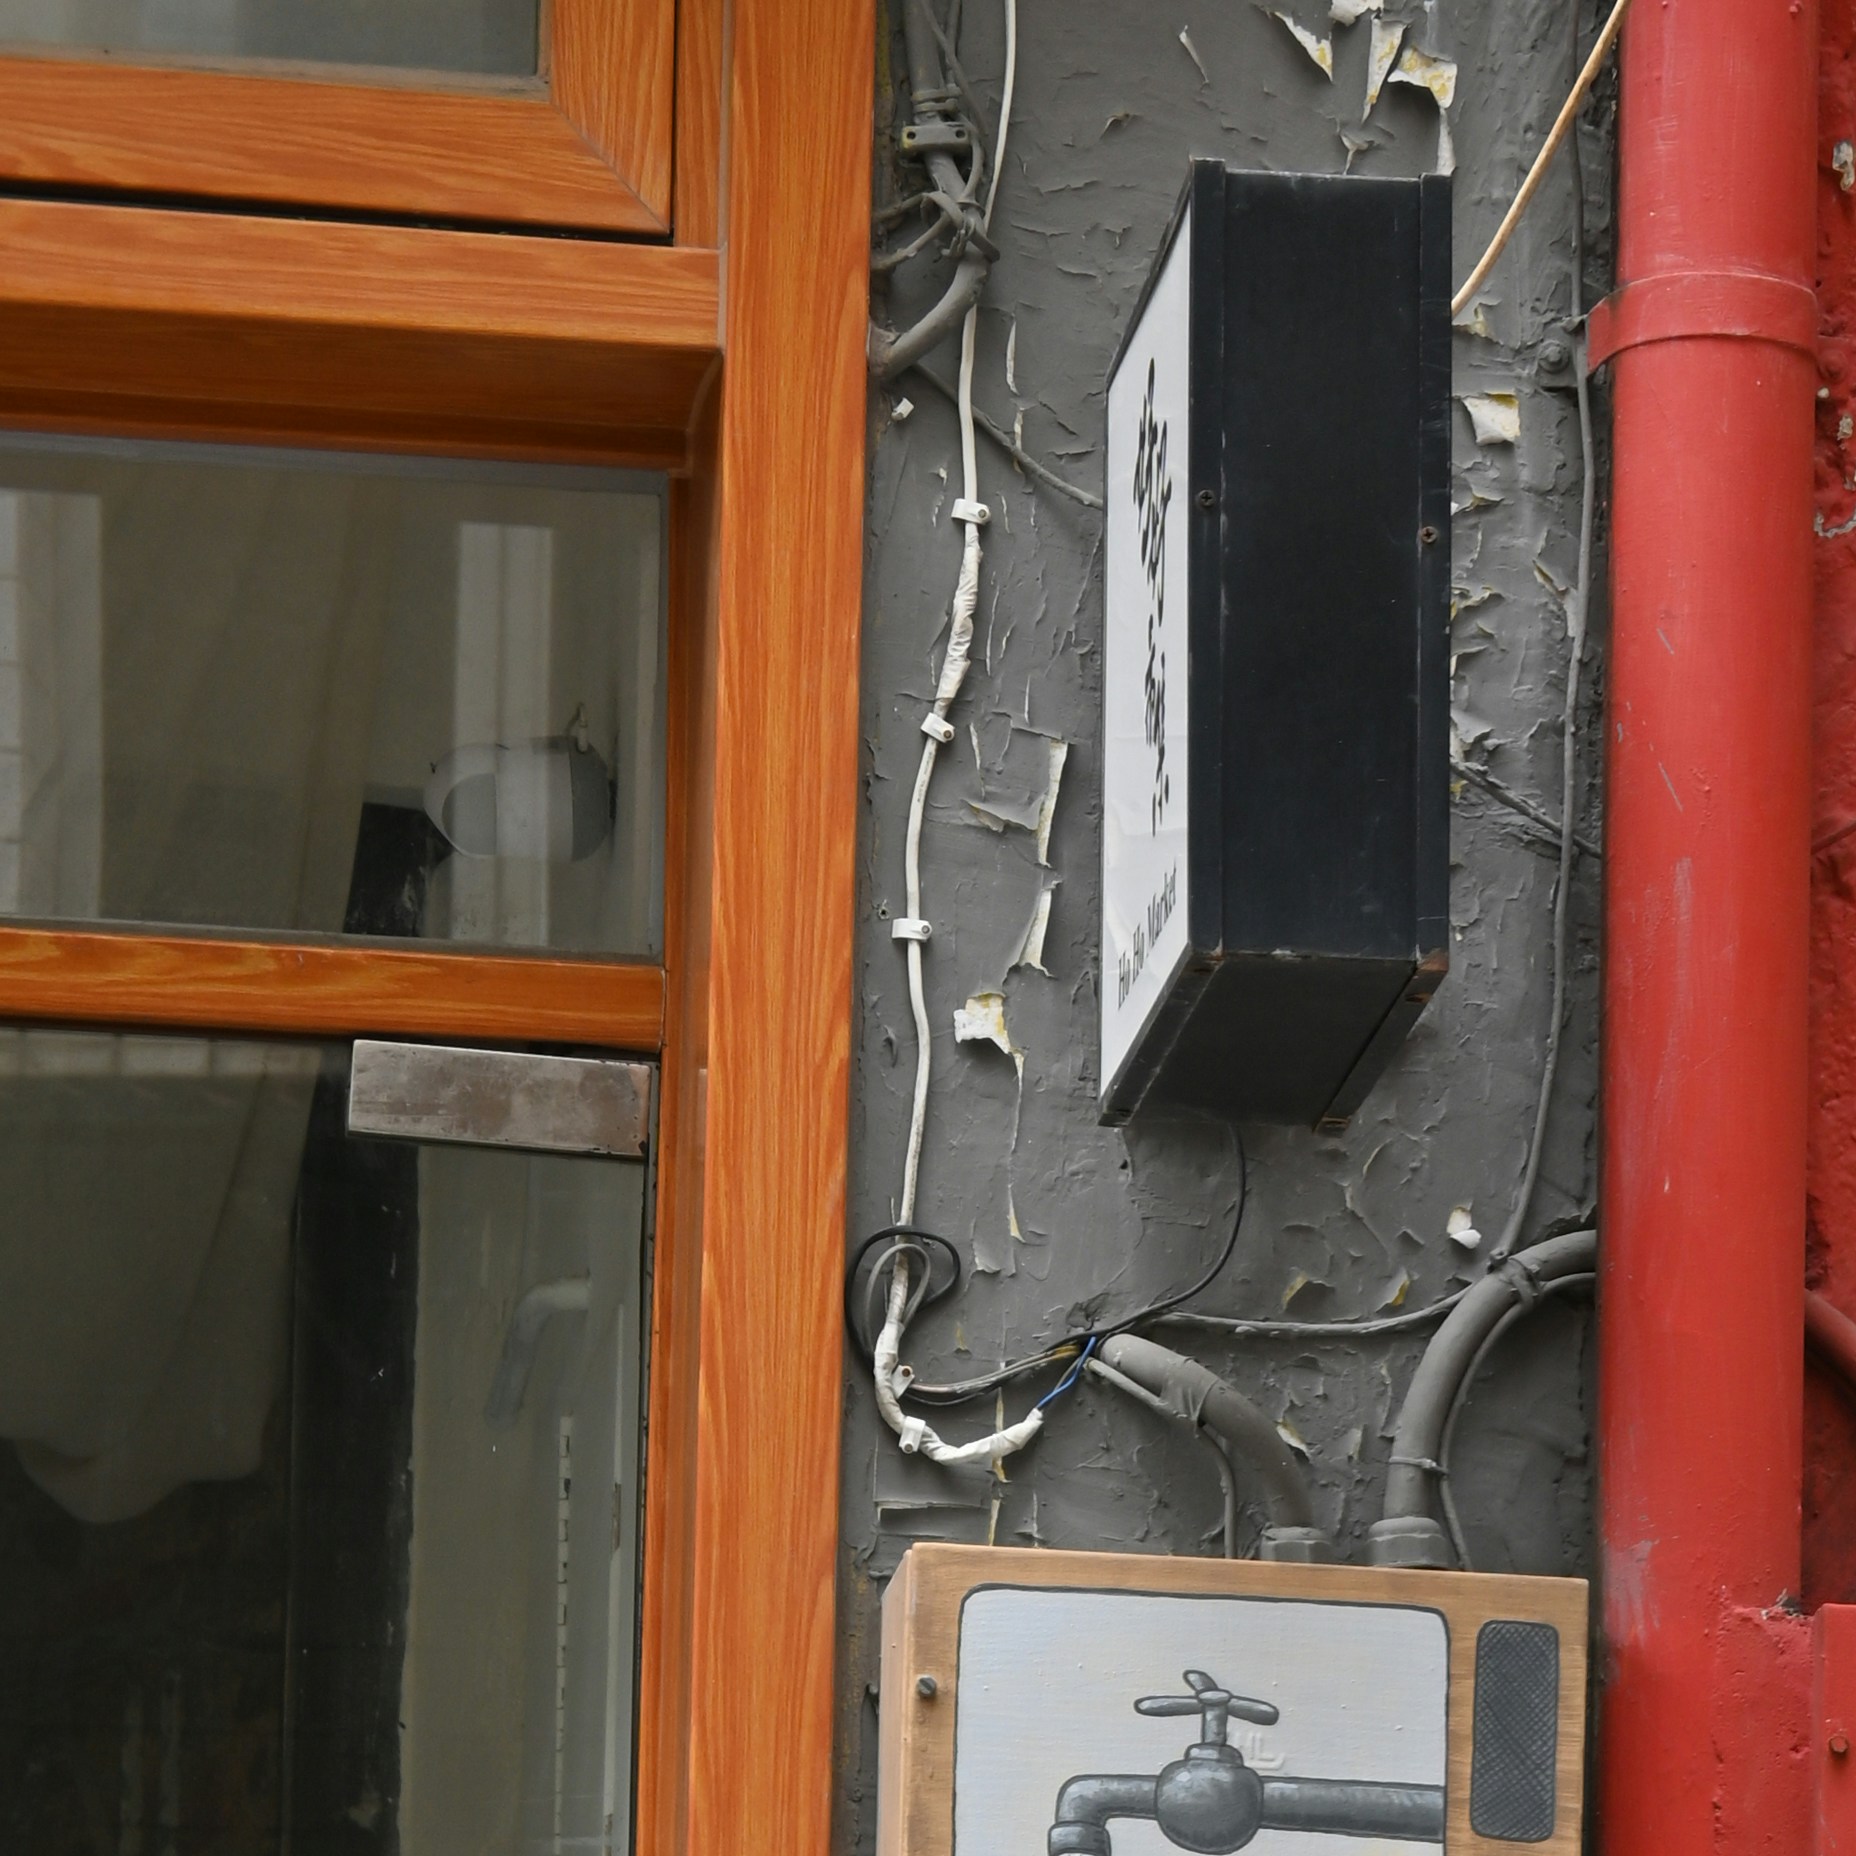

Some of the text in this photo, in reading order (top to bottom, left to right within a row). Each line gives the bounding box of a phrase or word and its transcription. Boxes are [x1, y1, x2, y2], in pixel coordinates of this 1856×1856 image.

[1118, 860, 1177, 1011] Ho Ho Market
